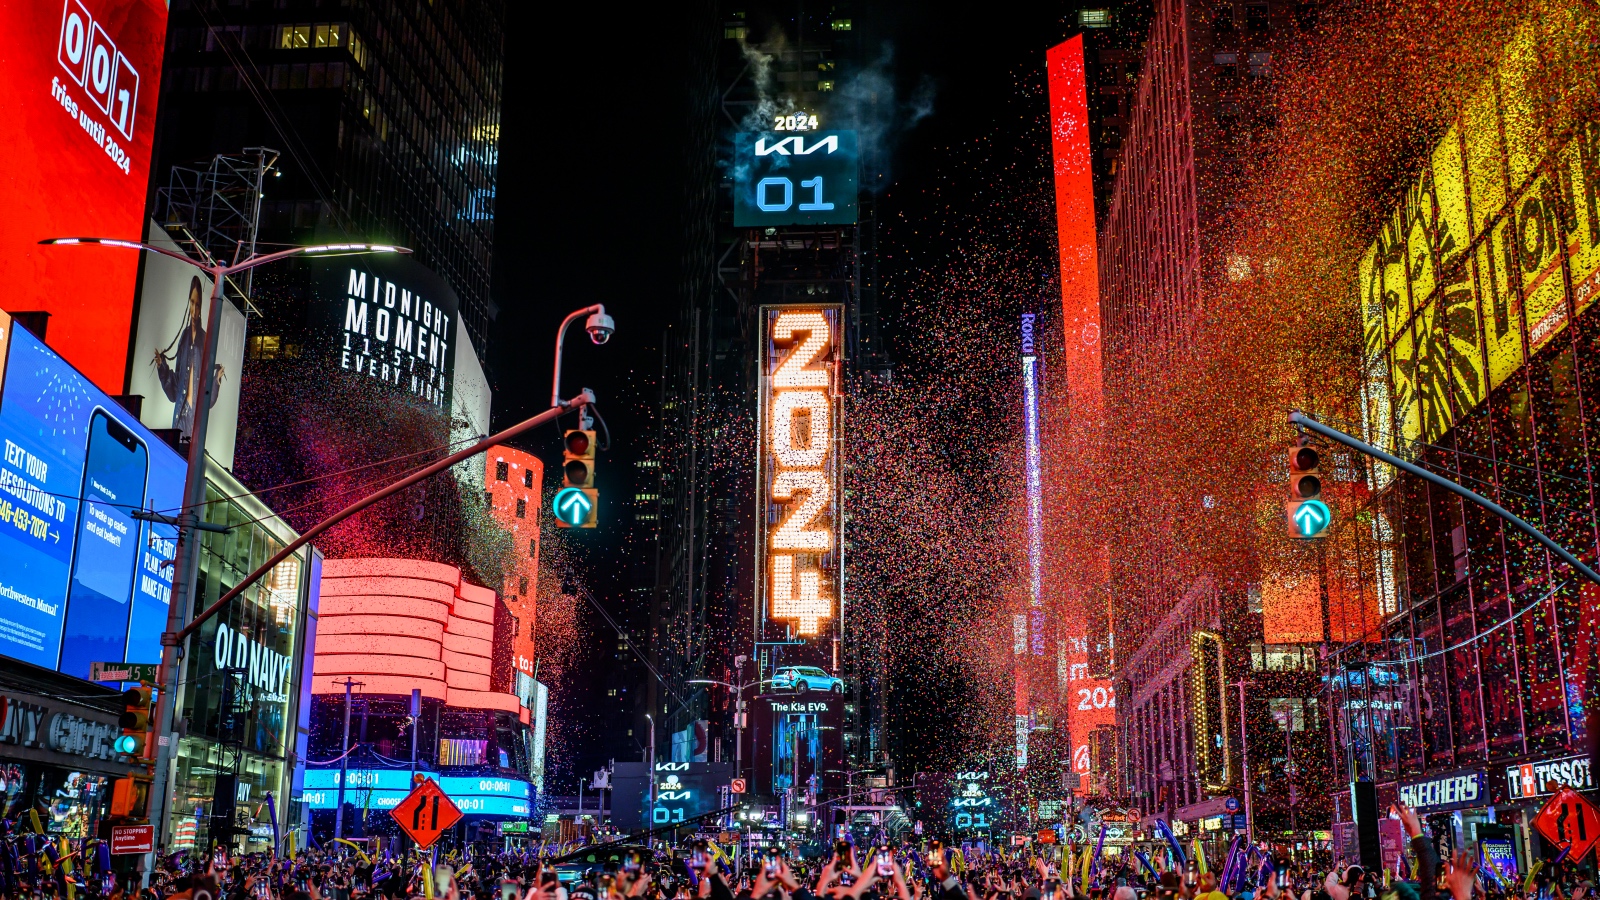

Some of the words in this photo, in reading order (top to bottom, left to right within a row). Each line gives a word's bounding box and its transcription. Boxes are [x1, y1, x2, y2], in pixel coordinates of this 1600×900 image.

[51, 76, 78, 119] fries
[79, 107, 105, 148] until
[104, 136, 130, 175] 2024
[774, 115, 818, 131] 2024
[757, 176, 834, 212] 01
[347, 268, 449, 340] MIDNIGHT
[344, 298, 447, 373] MOMENT
[1021, 313, 1036, 353] ROKU
[341, 350, 401, 385] EVERY
[411, 375, 444, 408] NIGHT
[342, 332, 415, 372] 11:57
[430, 367, 445, 391] PM
[4, 438, 26, 470] TEXT
[26, 452, 48, 484] YOUR
[773, 313, 832, 635] 2024
[0, 467, 55, 517] RESOLUTIONS
[55, 499, 66, 523] TO
[86, 521, 95, 534] and
[95, 525, 104, 538] eat
[95, 508, 107, 523] wake
[163, 539, 174, 560] GOT
[141, 574, 157, 598] MAKE
[157, 582, 163, 601] IT
[36, 597, 57, 617] Mutual
[127, 665, 141, 681] 45
[147, 666, 156, 676] St
[215, 622, 248, 670] OLD
[249, 639, 289, 697] NAVY
[771, 702, 788, 711] The
[790, 702, 806, 711] Kia
[808, 702, 829, 711] EV9.
[660, 782, 682, 790] 2024
[1400, 773, 1478, 808] SKECHERS
[1534, 758, 1592, 792] TISSOT
[955, 813, 990, 828] 01
